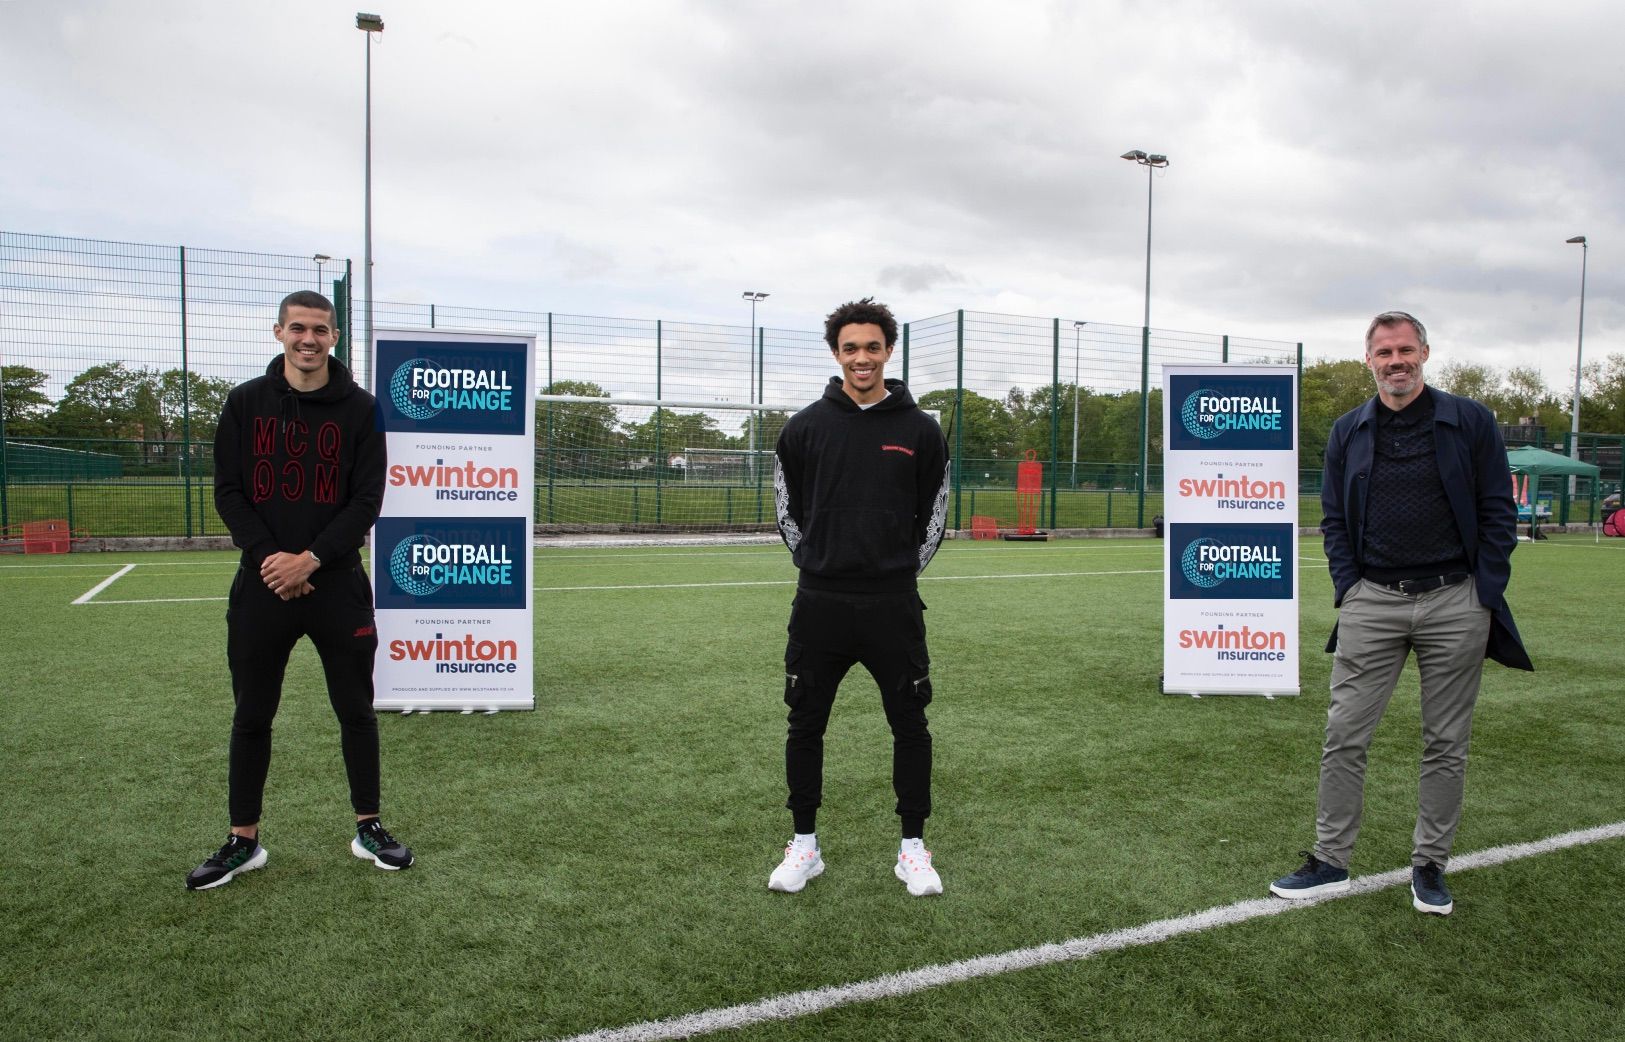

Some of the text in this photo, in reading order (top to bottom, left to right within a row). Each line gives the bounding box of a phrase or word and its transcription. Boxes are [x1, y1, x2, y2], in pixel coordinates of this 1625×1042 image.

[413, 368, 512, 390] FOOTBALL
[412, 389, 512, 411] FOR CHANGE
[1200, 396, 1281, 413] FOOTBALL
[1199, 414, 1281, 430] FOR CHANGE
[254, 417, 341, 464] MCQ
[389, 458, 518, 488] swinton
[436, 489, 518, 501] insurance
[1179, 473, 1285, 499] swinton
[1217, 499, 1285, 510] insurance
[412, 544, 512, 564] FOOTBALL
[1200, 545, 1281, 562] FOOTBALL
[412, 564, 512, 585] FOR CHANGE
[1199, 562, 1281, 579] FOR CHANGE
[389, 633, 517, 661] swinton
[1179, 624, 1285, 650] swinton
[1217, 650, 1285, 661] insurance
[436, 662, 517, 673] insurance
